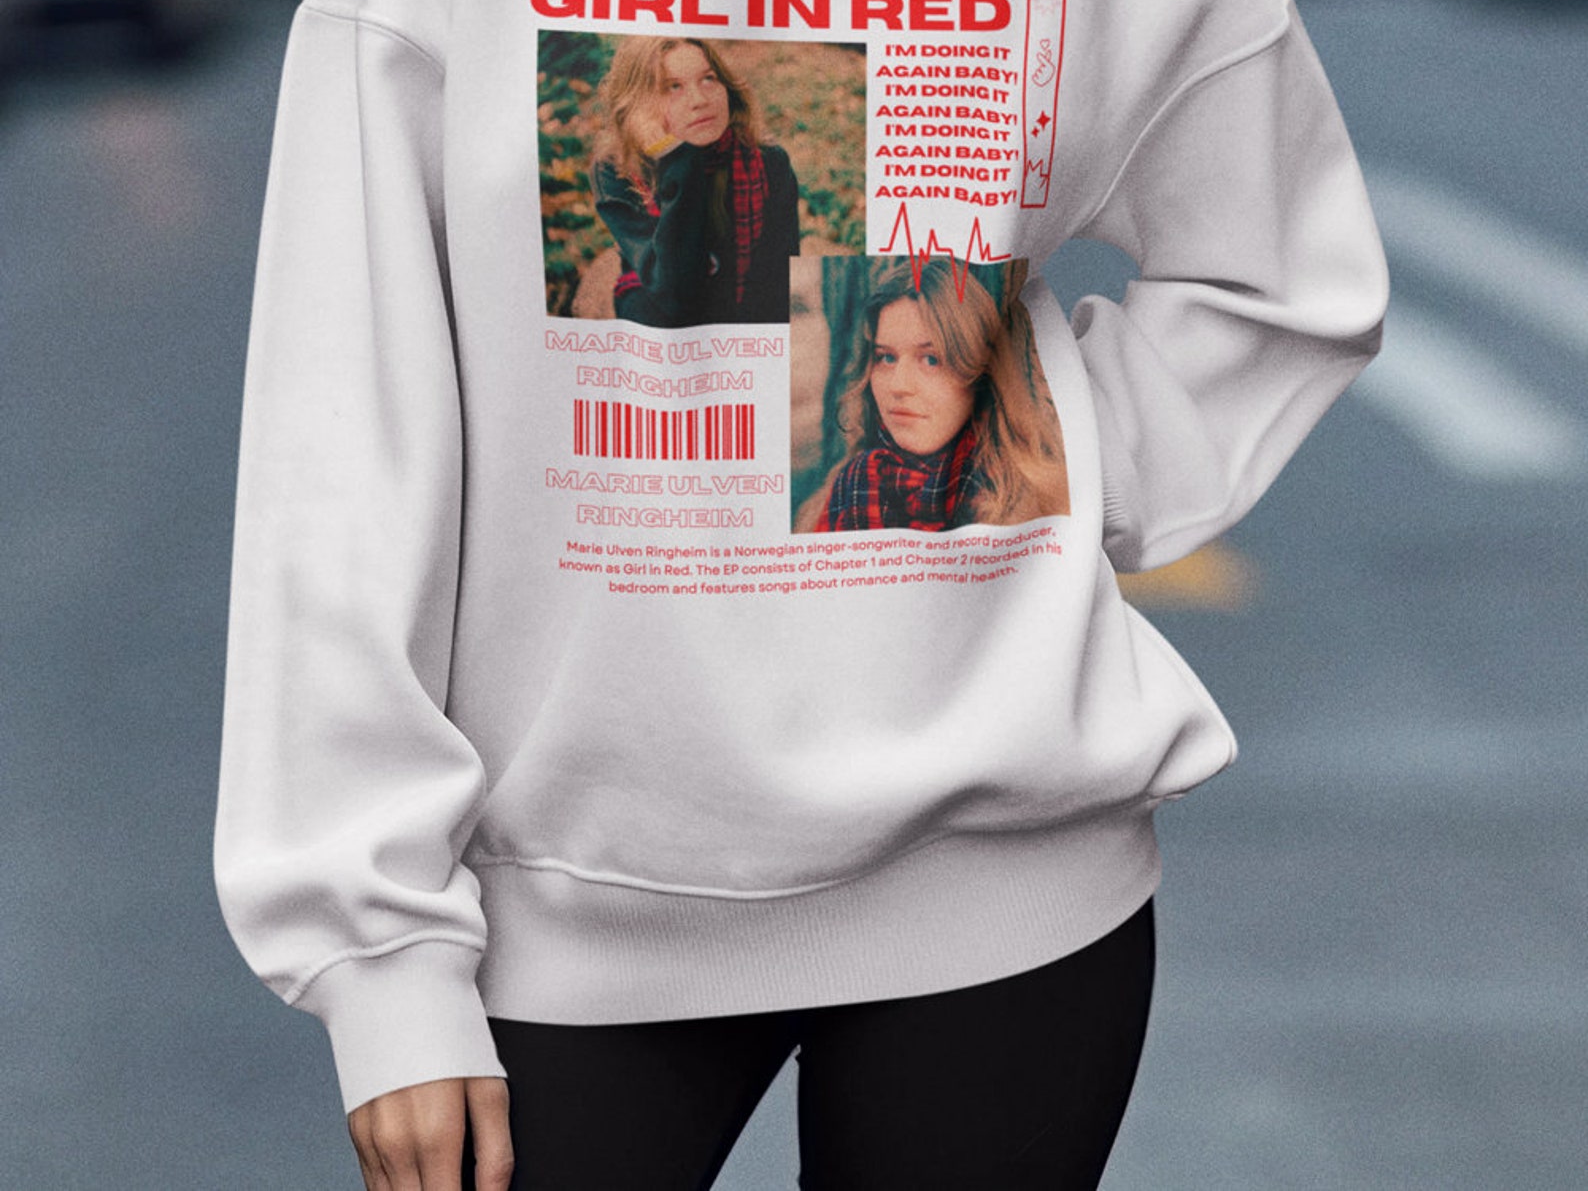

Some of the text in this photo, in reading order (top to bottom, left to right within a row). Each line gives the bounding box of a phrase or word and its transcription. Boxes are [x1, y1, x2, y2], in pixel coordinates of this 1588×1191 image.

[885, 44, 1011, 61] I'M DOING IT
[876, 65, 1018, 85] AGAIN BABY!
[885, 84, 1009, 104] I'M DOING IT
[876, 105, 1018, 126] AGAIN BABY!
[885, 124, 1011, 142] I'M DOING IT
[875, 145, 1019, 161] AGAIN BABY!
[884, 164, 1011, 182] I'M DOING IT
[875, 186, 1018, 207] AGAIN BABY!
[545, 330, 784, 365] MARIE ULVEN
[577, 365, 753, 398] RINGHEIM
[546, 468, 784, 496] MARIE ULVEN
[577, 504, 753, 528] RINGHEIM
[566, 540, 603, 555] Marie
[606, 544, 643, 557] Ulven
[646, 545, 707, 560] Ringheim
[710, 546, 721, 558] is
[723, 548, 731, 557] a
[734, 543, 804, 557] Norwegian
[806, 536, 921, 554] singer-songwriter
[925, 540, 951, 550] and
[952, 535, 990, 549] record
[558, 558, 603, 572] known
[605, 564, 621, 574] as
[623, 563, 646, 575] Girl
[649, 564, 662, 575] in
[664, 564, 693, 576] Red.
[696, 564, 721, 576] The
[723, 564, 739, 576] EP
[741, 563, 796, 575] consists
[798, 560, 812, 572] of
[815, 558, 868, 572] Chapter
[870, 557, 876, 566] 1
[878, 554, 902, 567] and
[905, 553, 958, 567] Chapter
[960, 555, 968, 566] 2
[969, 546, 1029, 565] recorded
[1031, 544, 1045, 555] in
[608, 565, 1019, 594] bedroom and features songs about romance and mental health.
